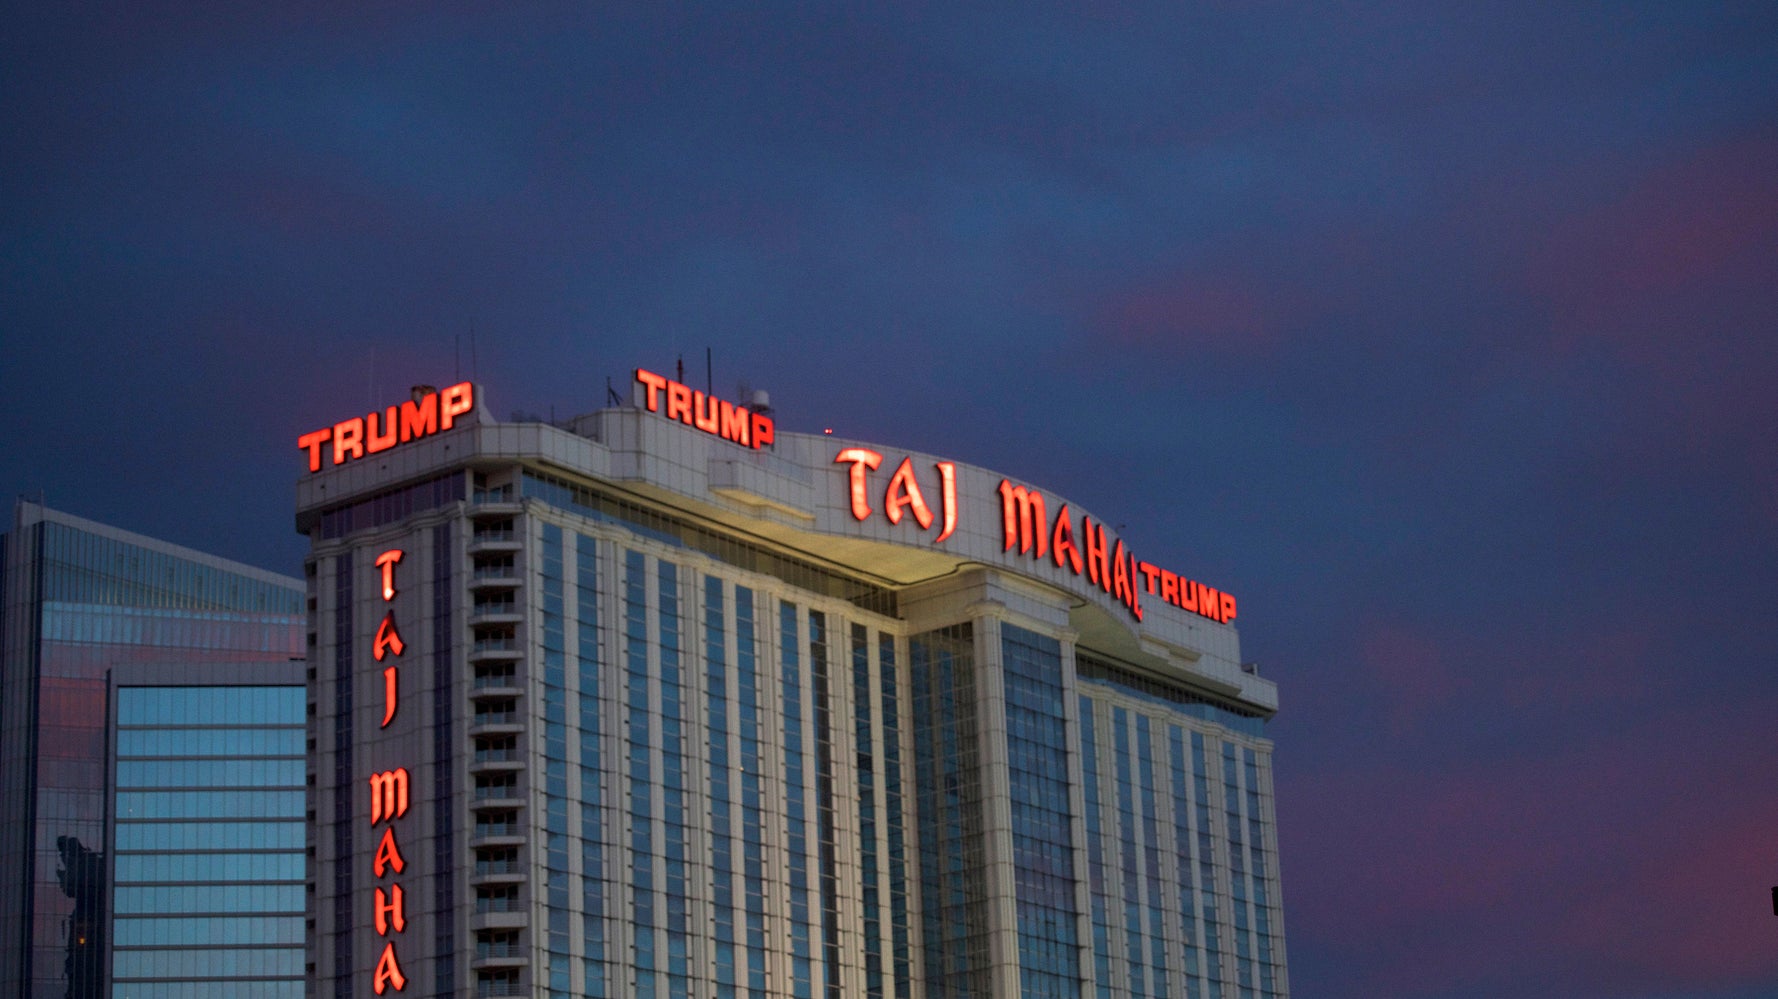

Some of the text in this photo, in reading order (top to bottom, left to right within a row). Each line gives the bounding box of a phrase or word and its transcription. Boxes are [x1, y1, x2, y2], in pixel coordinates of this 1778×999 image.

[298, 381, 473, 473] TRUMP
[636, 368, 774, 450] TRUMP
[835, 447, 1143, 621] TAJ MAHAL
[373, 549, 403, 728] TAJ
[1139, 561, 1237, 624] TRUMP
